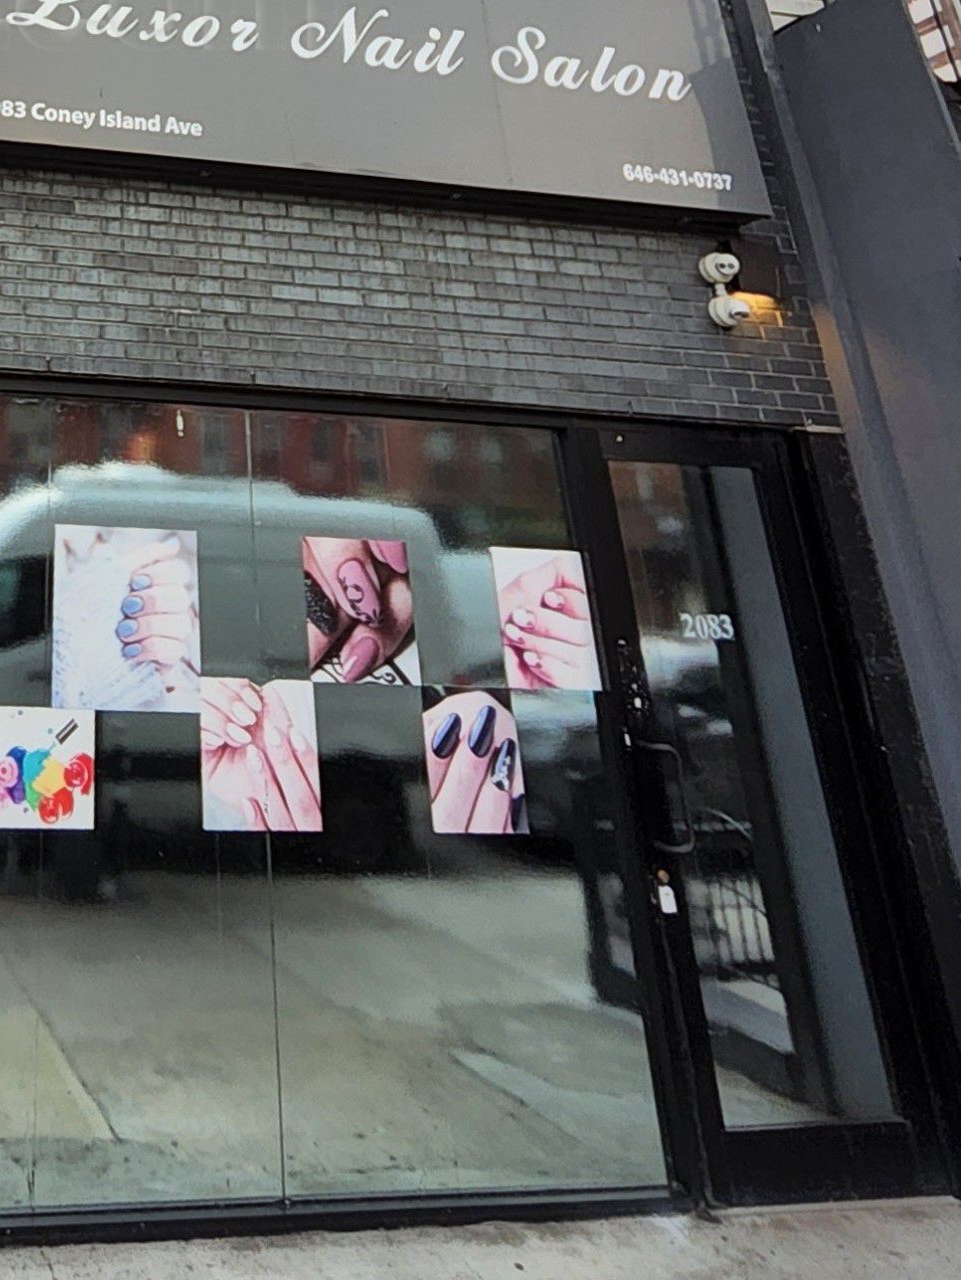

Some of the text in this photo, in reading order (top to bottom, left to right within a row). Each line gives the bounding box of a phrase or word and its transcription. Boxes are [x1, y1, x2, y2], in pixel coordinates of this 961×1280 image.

[291, 6, 465, 76] Nail
[491, 26, 694, 102] Salon
[30, 102, 96, 130] Coney
[99, 108, 162, 133] Island
[165, 116, 203, 137] Ave
[622, 163, 733, 191] 646-431-0737
[681, 613, 735, 641] 2083
